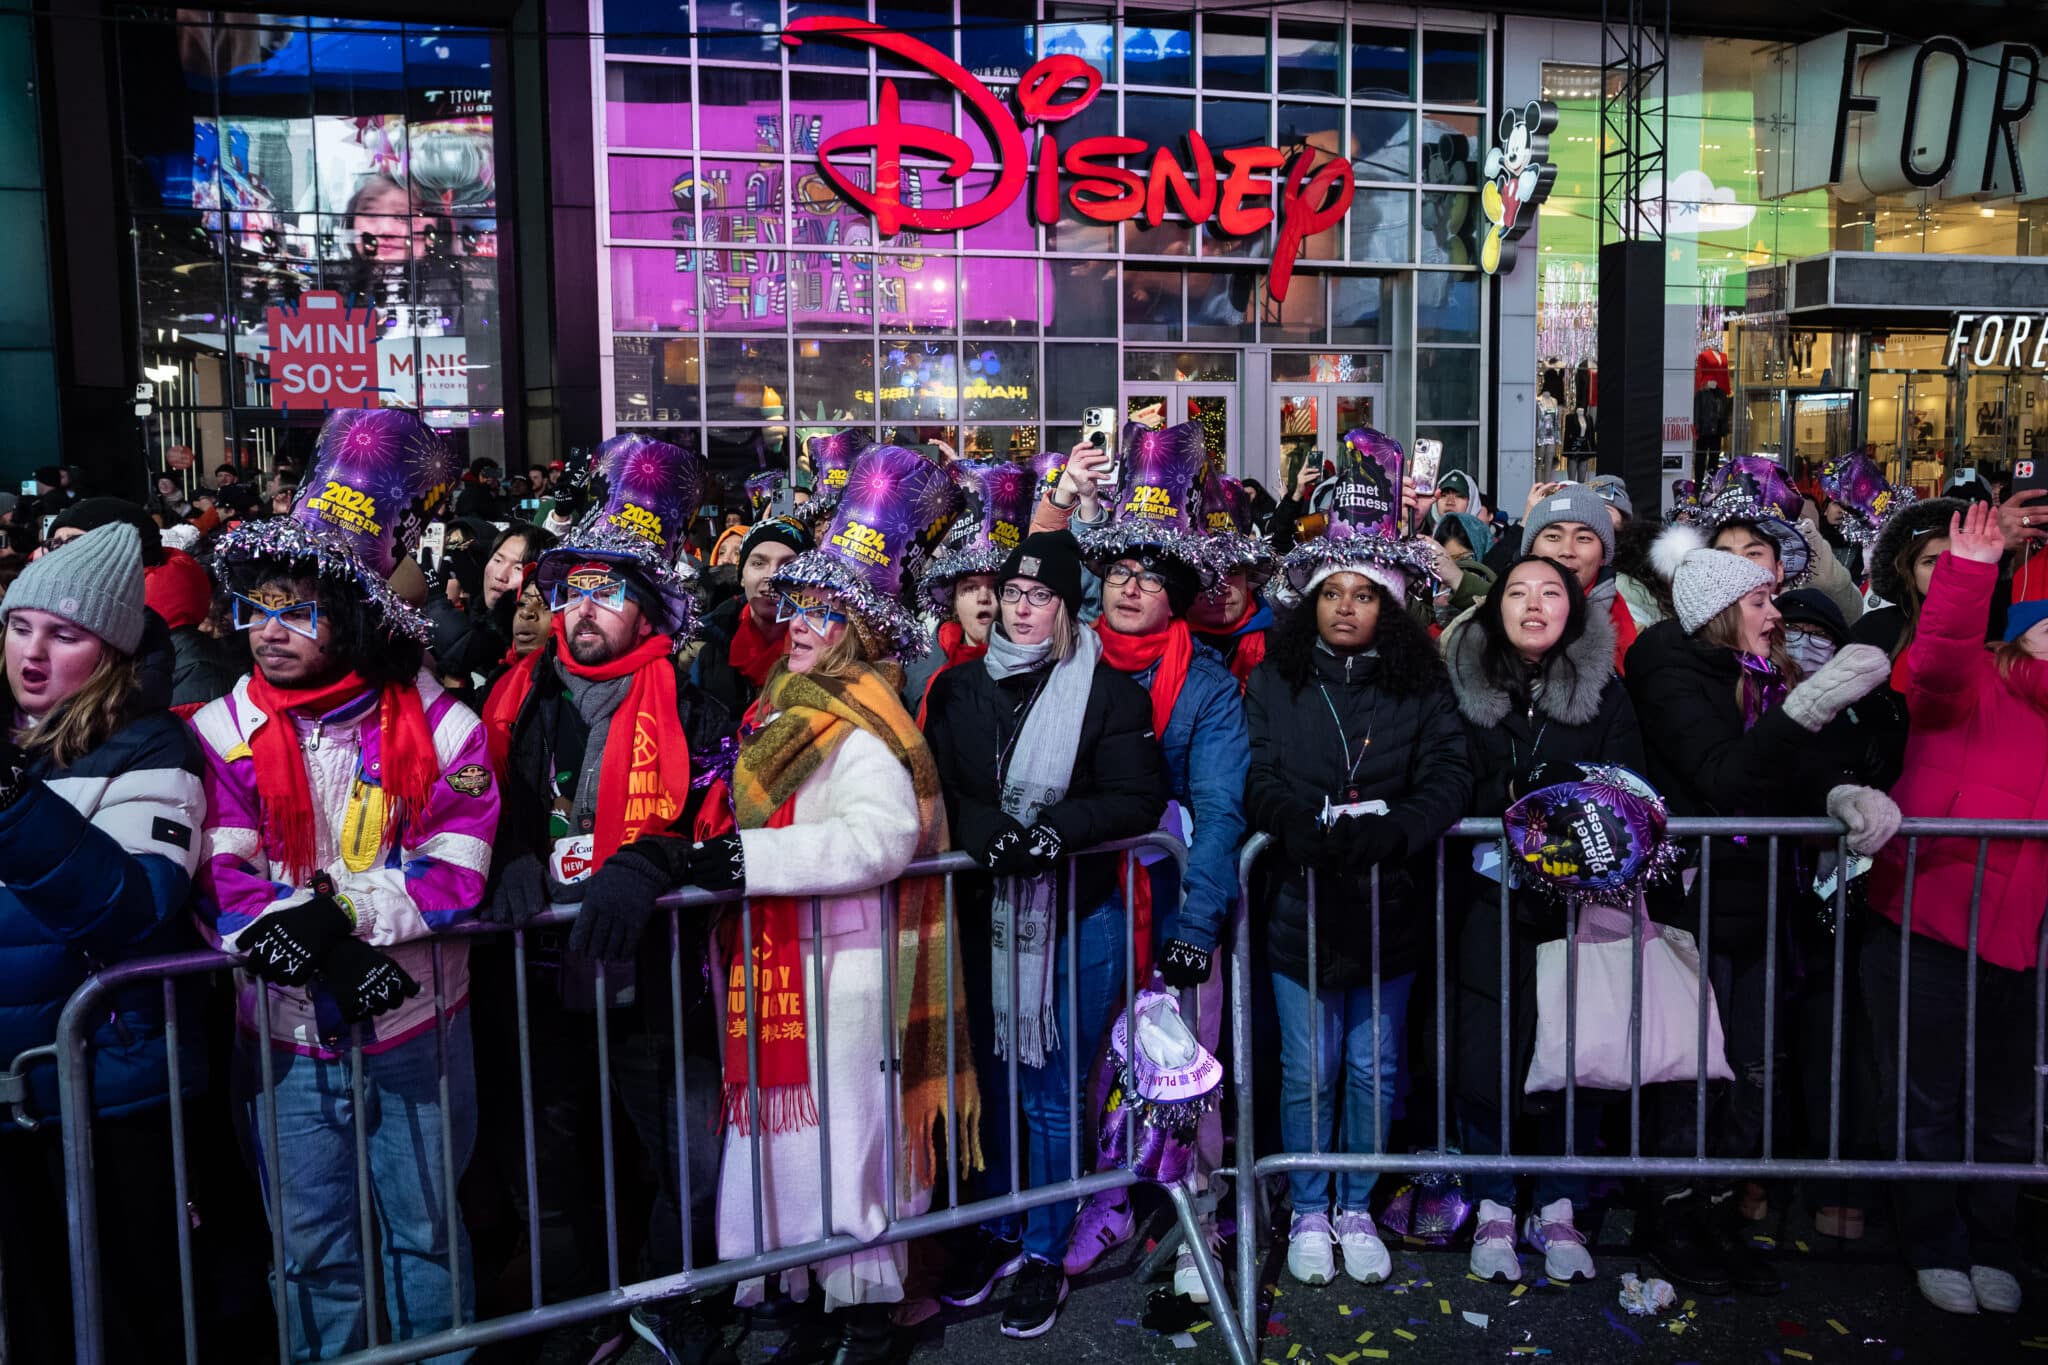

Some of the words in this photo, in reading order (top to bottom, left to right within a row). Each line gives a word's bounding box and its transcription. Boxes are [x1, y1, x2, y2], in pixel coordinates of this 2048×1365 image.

[1829, 28, 2040, 195] FOR
[280, 323, 366, 354] MINI
[1947, 314, 2048, 368] FORE
[282, 363, 332, 394] SO
[389, 353, 468, 377] MNIS
[827, 469, 848, 480] 202
[1335, 480, 1380, 499] planet
[321, 481, 375, 518] 2024
[1124, 502, 1140, 513] NEW
[1163, 506, 1178, 518] EVE
[1132, 485, 1171, 506] 2024
[1338, 494, 1389, 512] fitness
[306, 497, 332, 511] NEW
[331, 504, 365, 526] YEAR'S
[362, 519, 382, 537] EVE
[319, 510, 339, 525] TIMES
[338, 519, 363, 536] SQUARE
[621, 502, 662, 534] 2024
[994, 520, 1020, 541] 2024
[831, 534, 851, 549] NEW
[850, 539, 877, 560] YEAR'S
[874, 551, 892, 568] EVE
[843, 521, 886, 552] 2024
[1571, 818, 1608, 874] planet
[1584, 802, 1616, 863] fitness
[563, 860, 584, 873] NEW
[254, 939, 299, 976] KAY
[1167, 951, 1207, 970] KAY
